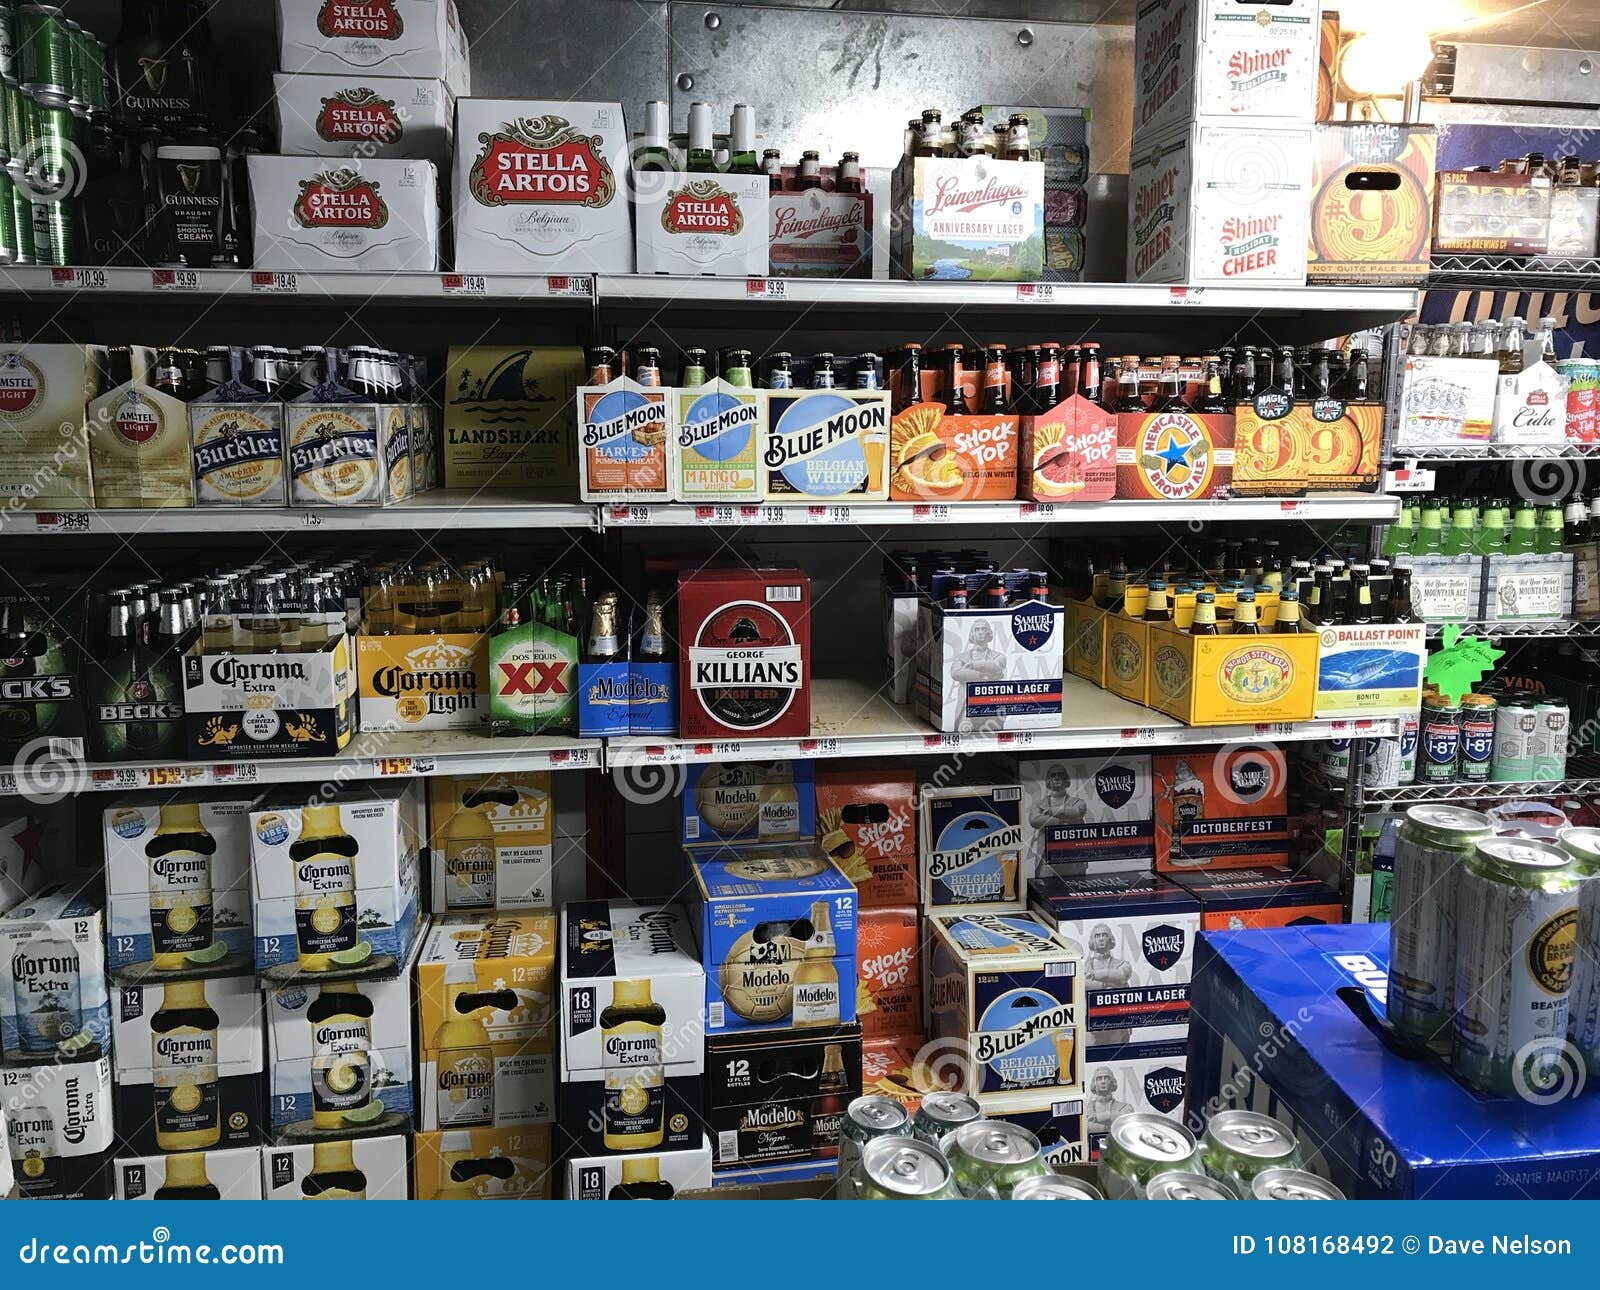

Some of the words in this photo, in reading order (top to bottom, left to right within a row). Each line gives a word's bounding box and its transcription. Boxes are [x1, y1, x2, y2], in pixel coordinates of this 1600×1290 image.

[333, 5, 387, 18] STELLA
[333, 18, 389, 30] ARTOIS
[1227, 48, 1291, 79] Shiner
[126, 96, 190, 110] GUINNESS
[332, 109, 386, 122] STELLA
[332, 122, 387, 134] ARTOIS
[498, 152, 588, 172] STELLA
[497, 172, 589, 193] ARTOIS
[166, 195, 220, 206] GUINNESS
[312, 193, 370, 206] STELLA
[312, 206, 372, 220] ARTOIS
[678, 202, 728, 214] STELLA
[519, 210, 569, 225] Belgium
[678, 214, 729, 227] ARTOIS
[770, 204, 864, 241] Leinenkugel's
[933, 222, 993, 234] ANNIVERSARY
[996, 223, 1024, 235] LAGER
[1220, 211, 1282, 244] Shiner
[1222, 250, 1276, 276] CHEER
[76, 271, 105, 286] $10.99
[176, 272, 196, 286] $9.99
[274, 274, 296, 288] $19.49
[463, 278, 485, 291] $19.49
[568, 278, 590, 293] $10.99
[768, 280, 785, 295] $9.99
[1258, 394, 1288, 406] MAGIC
[1314, 400, 1342, 411] MAGIC
[120, 412, 154, 422] AMSTEL
[1259, 408, 1286, 417] HAT
[1316, 412, 1339, 420] HAT
[1513, 406, 1556, 428] Cidre
[124, 423, 150, 432] LIGHT
[584, 420, 624, 446] BLUE
[626, 404, 665, 430] MOON
[678, 420, 717, 446] BLUE
[720, 406, 758, 430] MOON
[448, 428, 560, 444] LANDSHARK
[764, 436, 823, 468] BLUE
[827, 406, 886, 440] MOON
[954, 422, 1016, 451] SHOCK
[1145, 415, 1200, 451] NEWCASTLE
[1066, 428, 1116, 453] SHOCK
[1310, 428, 1340, 465] 9
[194, 436, 280, 468] Buckler
[292, 436, 376, 468] Buckler
[595, 447, 656, 458] HARVEST
[971, 442, 1008, 466] TOP
[1080, 442, 1112, 464] TOP
[806, 460, 864, 472] BELGIAN
[686, 470, 740, 483] MANGO
[806, 471, 866, 484] WHITE
[631, 506, 648, 520] $9.99
[716, 506, 733, 520] $9.99
[763, 506, 784, 521] $9.99
[1424, 588, 1454, 597] MOUNTAIN
[1456, 588, 1468, 596] ALE
[1519, 586, 1548, 595] MOUNTAIN
[1014, 614, 1054, 626] SAMUEL
[1016, 623, 1050, 634] ADAMS
[1338, 629, 1386, 642] BALLAST
[1390, 628, 1420, 640] POINT
[512, 654, 530, 662] DOS
[533, 652, 558, 660] EQUIS
[726, 650, 764, 659] GEORGE
[210, 657, 304, 688] Corona
[697, 660, 798, 683] KILLIAN'S
[372, 666, 478, 698] Corona
[497, 662, 569, 696] XX
[2, 678, 71, 698] CK'S
[244, 681, 276, 692] Extra
[598, 676, 660, 698] Modelo
[974, 684, 1014, 696] BOSTON
[1017, 683, 1050, 694] LAGER
[425, 690, 478, 715] Light
[100, 702, 184, 722] BECK'S
[1430, 741, 1457, 755] I-87
[1466, 739, 1492, 752] I-87
[570, 750, 588, 762] $9.49
[116, 769, 136, 782] $9.99
[234, 764, 257, 776] $10.49
[714, 789, 756, 804] Modelo
[258, 826, 288, 838] VIBES
[858, 816, 910, 846] SHOCK
[1054, 828, 1098, 840] BOSTON
[1102, 826, 1138, 838] LAGER
[1192, 820, 1272, 834] OCTOBERFEST
[872, 836, 906, 858] TOP
[154, 858, 206, 876] Corona
[298, 863, 351, 882] Corona
[448, 858, 494, 875] Corona
[168, 874, 199, 884] Extra
[313, 878, 343, 890] Extra
[950, 872, 1001, 885] BELGIAN
[950, 884, 1001, 896] WHITE
[835, 898, 852, 909] 12
[74, 922, 88, 934] 12
[116, 937, 136, 954] 12
[263, 938, 280, 954] 12
[1142, 934, 1184, 950] SAMUEL
[1146, 944, 1181, 957] ADAMS
[12, 954, 80, 983] Corona
[862, 947, 914, 980] SHOCK
[512, 968, 525, 982] 12
[742, 972, 790, 987] Modelo
[876, 966, 908, 990] TOP
[28, 979, 70, 993] Extra
[126, 990, 138, 1006] 12
[574, 992, 590, 1009] 18
[799, 988, 835, 1002] Modelo
[1096, 992, 1144, 1006] BOSTON
[1148, 990, 1186, 1002] LAGER
[316, 1026, 366, 1045] Corona
[977, 1032, 1027, 1062] BLUE
[1030, 1006, 1074, 1030] MOON
[157, 1037, 212, 1057] Corona
[606, 1036, 656, 1056] Corona
[172, 1054, 203, 1064] Extra
[620, 1053, 649, 1064] Extra
[1000, 1055, 1056, 1070] BELGIAN
[727, 1060, 750, 1077] 12
[1000, 1068, 1056, 1081] WHITE
[439, 1070, 491, 1092] Corona
[1146, 1077, 1186, 1090] SAMUEL
[1150, 1084, 1183, 1096] ADAMS
[62, 1077, 79, 1145] Corona
[280, 1096, 296, 1112] 12
[748, 1106, 796, 1127] Modelo
[8, 1118, 54, 1138] Corona
[18, 1135, 46, 1145] Extra
[758, 1132, 786, 1146] Negra
[276, 1157, 289, 1171] 12
[1370, 1138, 1397, 1178] 30
[128, 1170, 140, 1183] 12
[583, 1172, 599, 1188] 18
